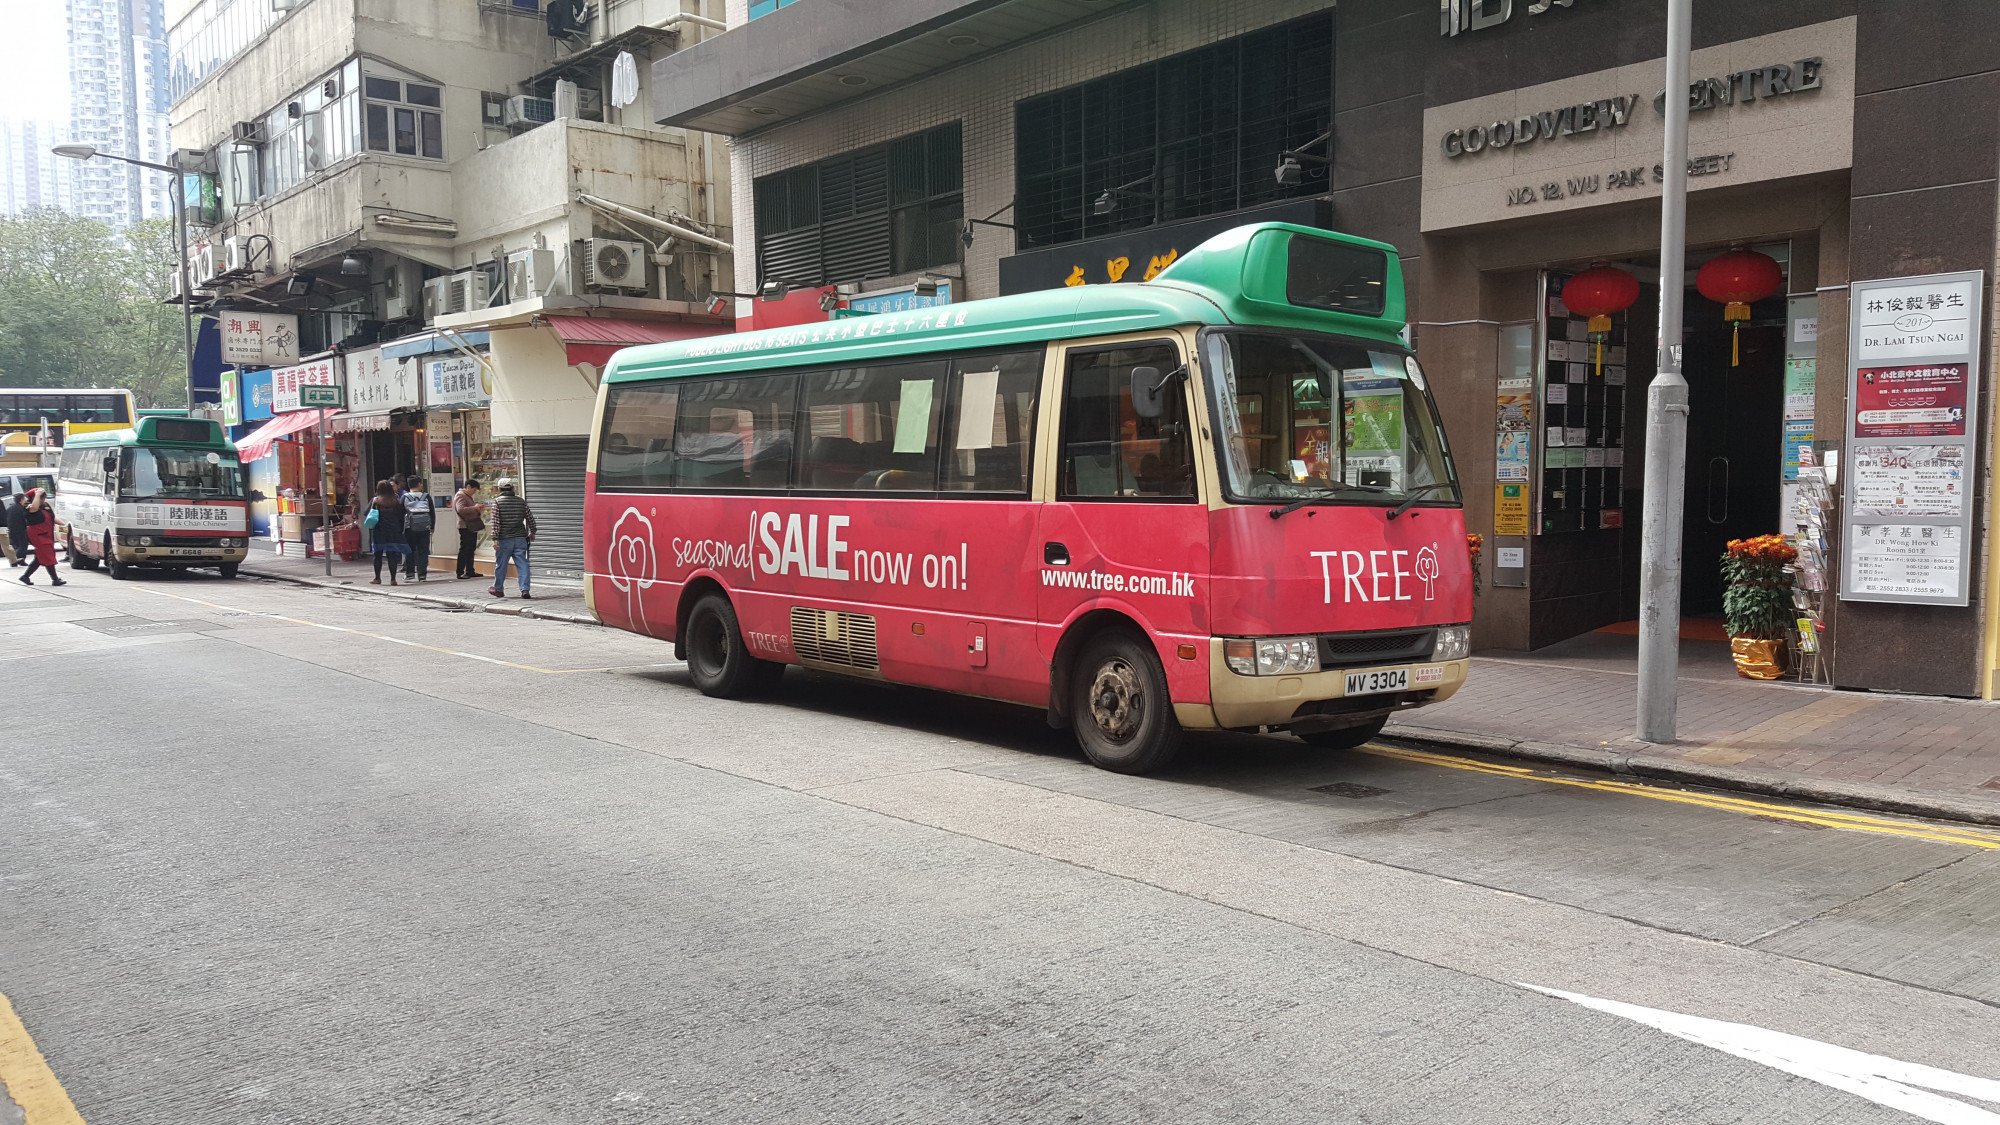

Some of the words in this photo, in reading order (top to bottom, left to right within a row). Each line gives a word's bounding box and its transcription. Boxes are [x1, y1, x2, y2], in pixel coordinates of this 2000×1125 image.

[1441, 93, 1639, 159] GOODVIEW
[1506, 185, 1536, 206] NO.
[1540, 181, 1563, 200] 12,
[1567, 174, 1599, 197] WU
[1605, 167, 1645, 190] PAK
[1653, 152, 1734, 183] SREET
[1866, 292, 1965, 314] 林俊毅醫生
[228, 319, 261, 335] 潮興
[684, 342, 715, 358] PUBLIC
[716, 340, 742, 354] LIGHT
[743, 338, 763, 351] BUS
[765, 337, 774, 348] 16
[775, 331, 809, 347] SEATS
[811, 309, 968, 343] 公共小型巴士十六座位
[1905, 318, 1923, 328] 201
[1864, 338, 1882, 347] DR.
[1884, 337, 1905, 346] LAM
[1908, 335, 1935, 344] TSUN
[1937, 333, 1964, 343] NGAI
[169, 507, 228, 521] 陸陳漢語
[1860, 526, 1955, 539] 黃孝基醫生
[1889, 539, 1909, 547] Wong
[672, 510, 757, 582] seasonal
[758, 511, 850, 581] SALE
[854, 549, 913, 586] now
[922, 543, 968, 590] on!
[1041, 568, 1195, 598] www.tree.com.hk
[1310, 549, 1411, 604] TREE
[748, 631, 781, 653] TREE
[1347, 674, 1366, 693] MV
[1369, 670, 1406, 690] 3304
